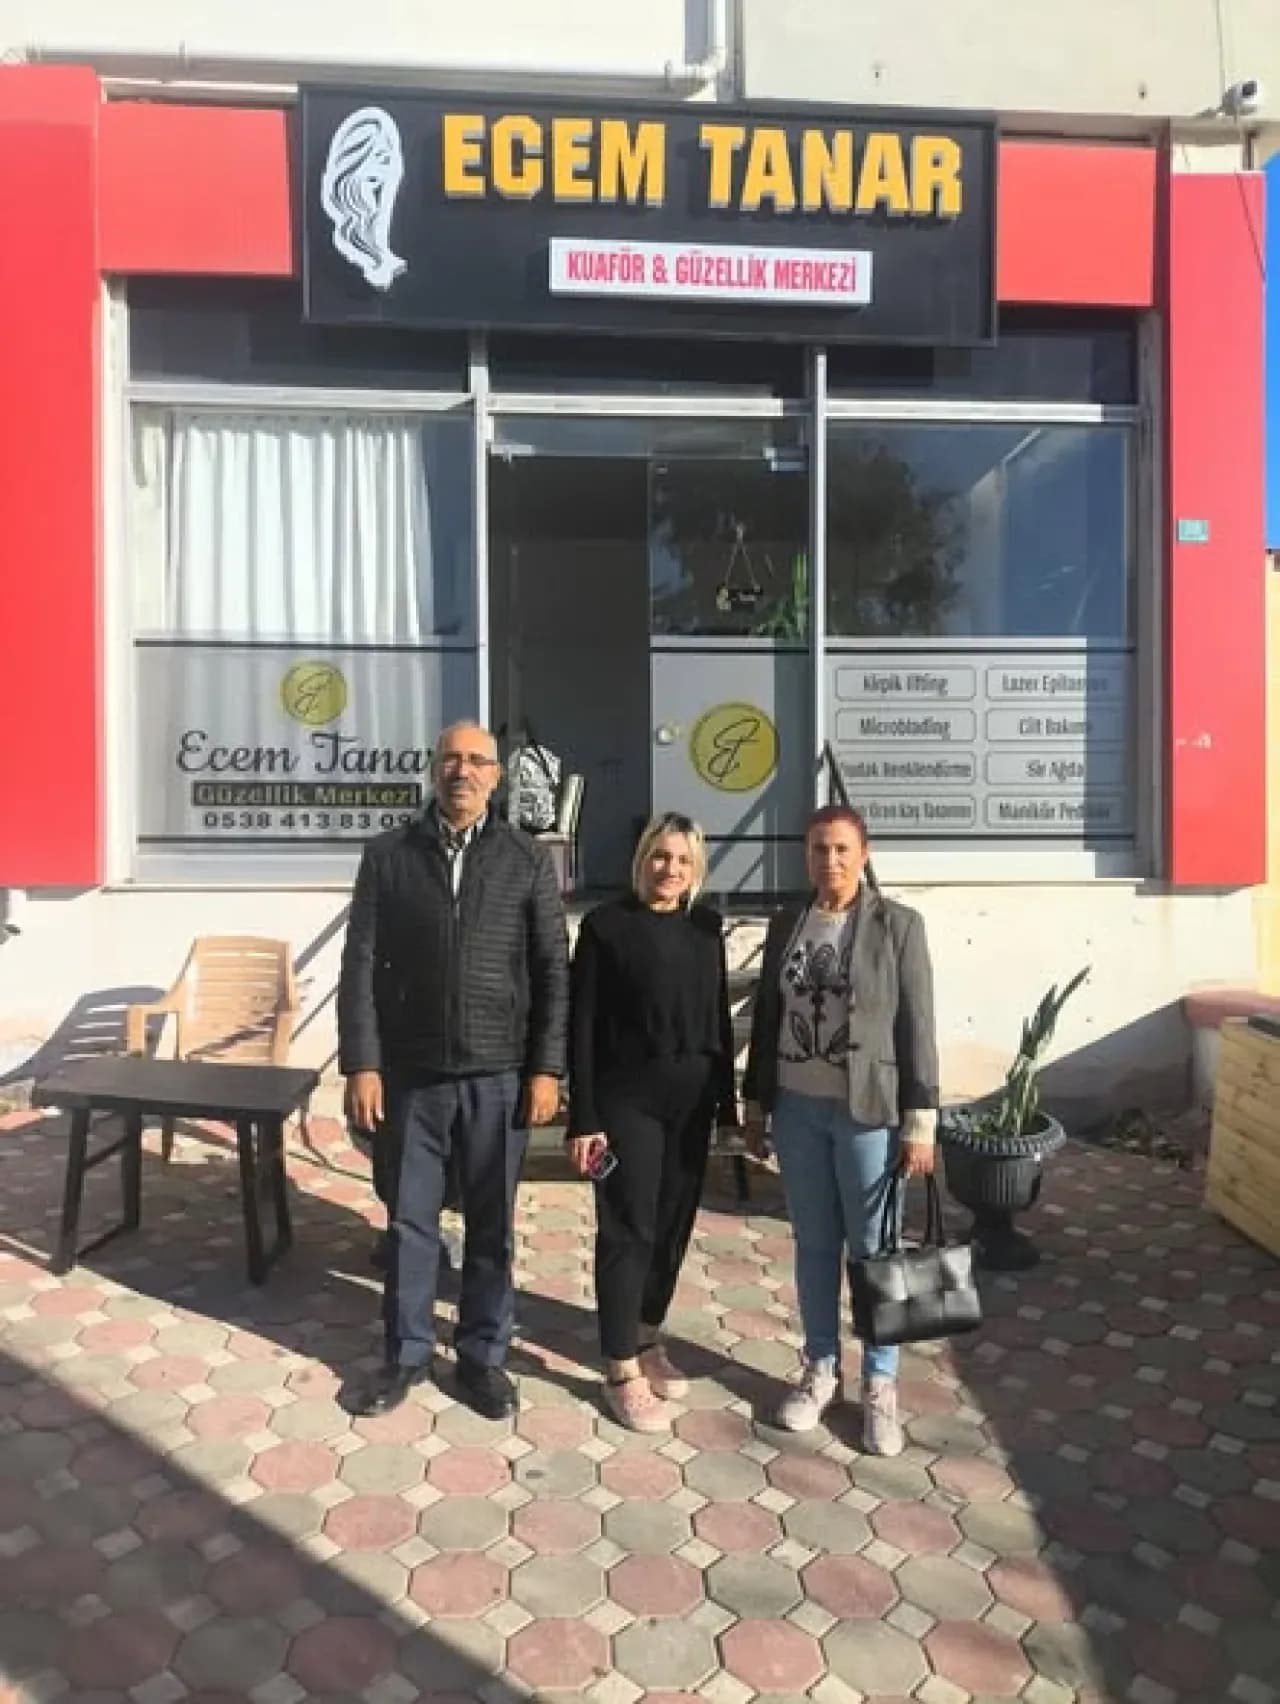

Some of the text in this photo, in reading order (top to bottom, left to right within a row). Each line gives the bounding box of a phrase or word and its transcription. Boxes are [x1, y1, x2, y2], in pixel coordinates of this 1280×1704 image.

[442, 114, 964, 219] ECEM TANAR
[568, 245, 856, 292] KUAFÖR & GÜZELLİK MERKEZİ
[176, 730, 299, 774] Ecem
